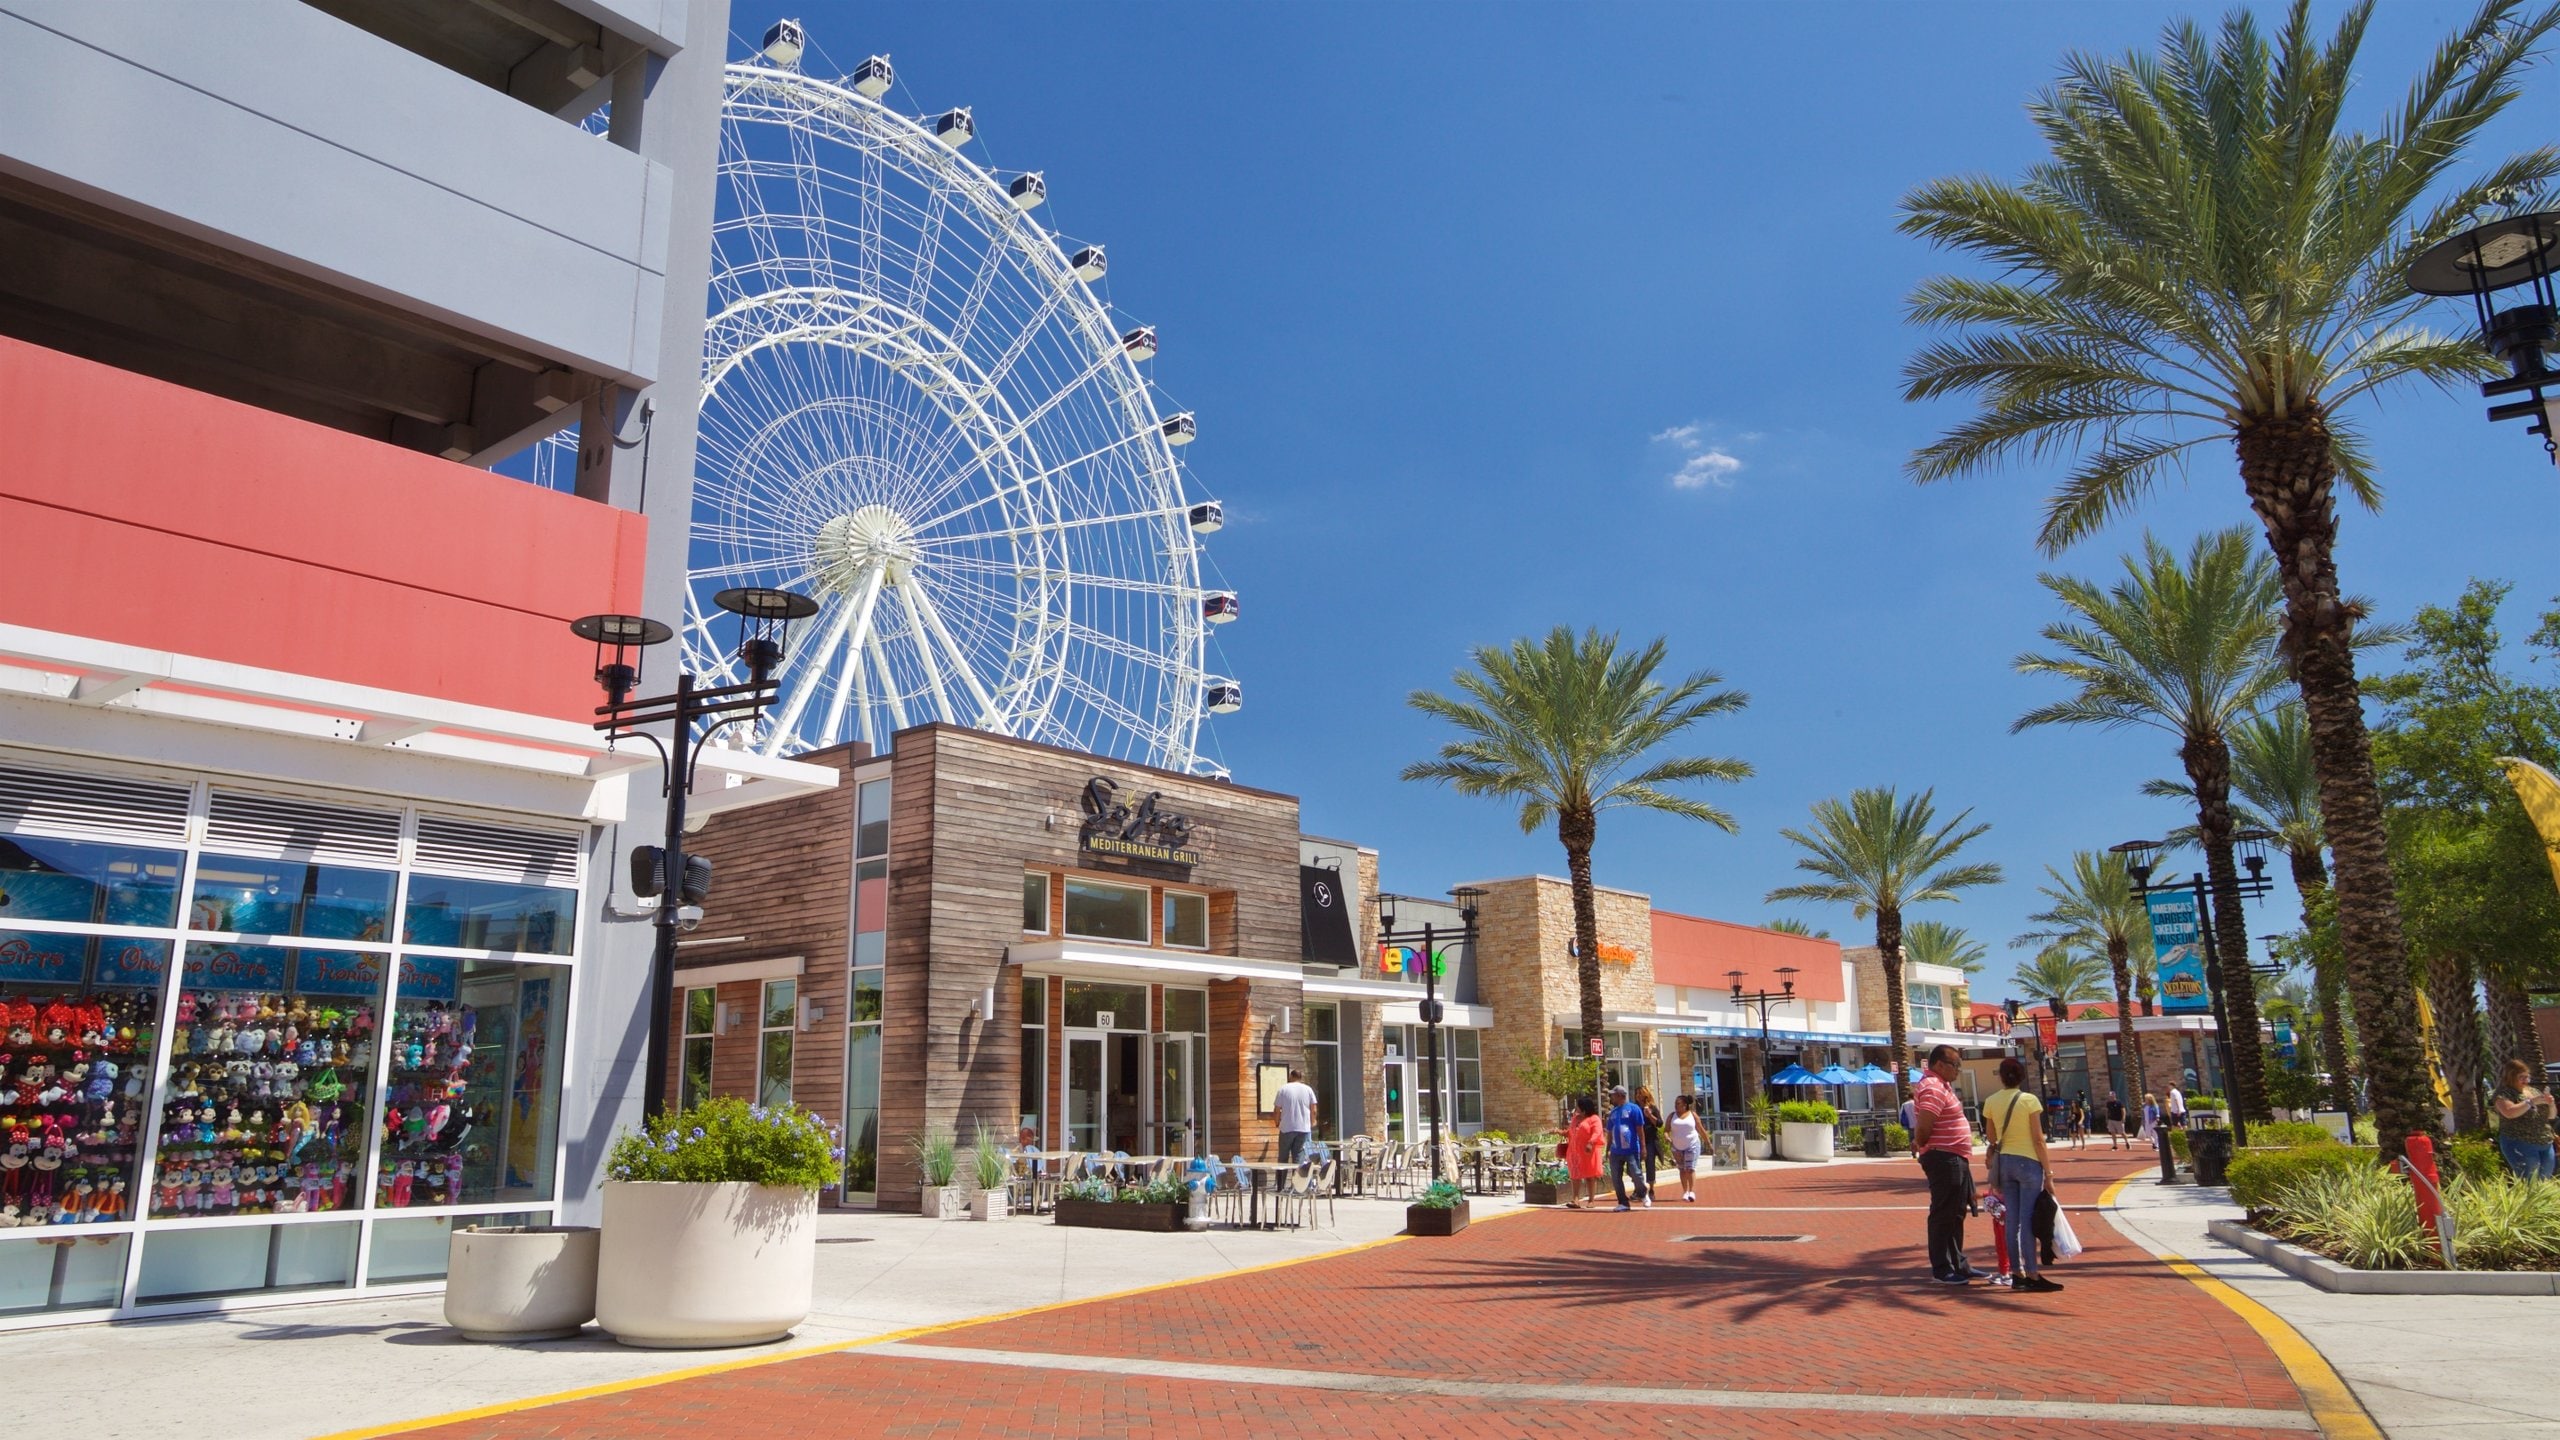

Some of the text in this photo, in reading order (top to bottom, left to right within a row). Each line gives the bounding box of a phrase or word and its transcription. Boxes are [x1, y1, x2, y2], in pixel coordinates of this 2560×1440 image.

[1087, 776, 1197, 841] Sofra
[1090, 837, 1198, 865] MEDITERRANEAN GRILL
[2151, 902, 2192, 914] AMERICA'S
[2152, 911, 2193, 925] LARGEST
[2154, 922, 2195, 935] SKELETON
[2156, 933, 2195, 946] MUSEUM
[119, 946, 204, 973] ORLDO
[1101, 1014, 1111, 1026] 60
